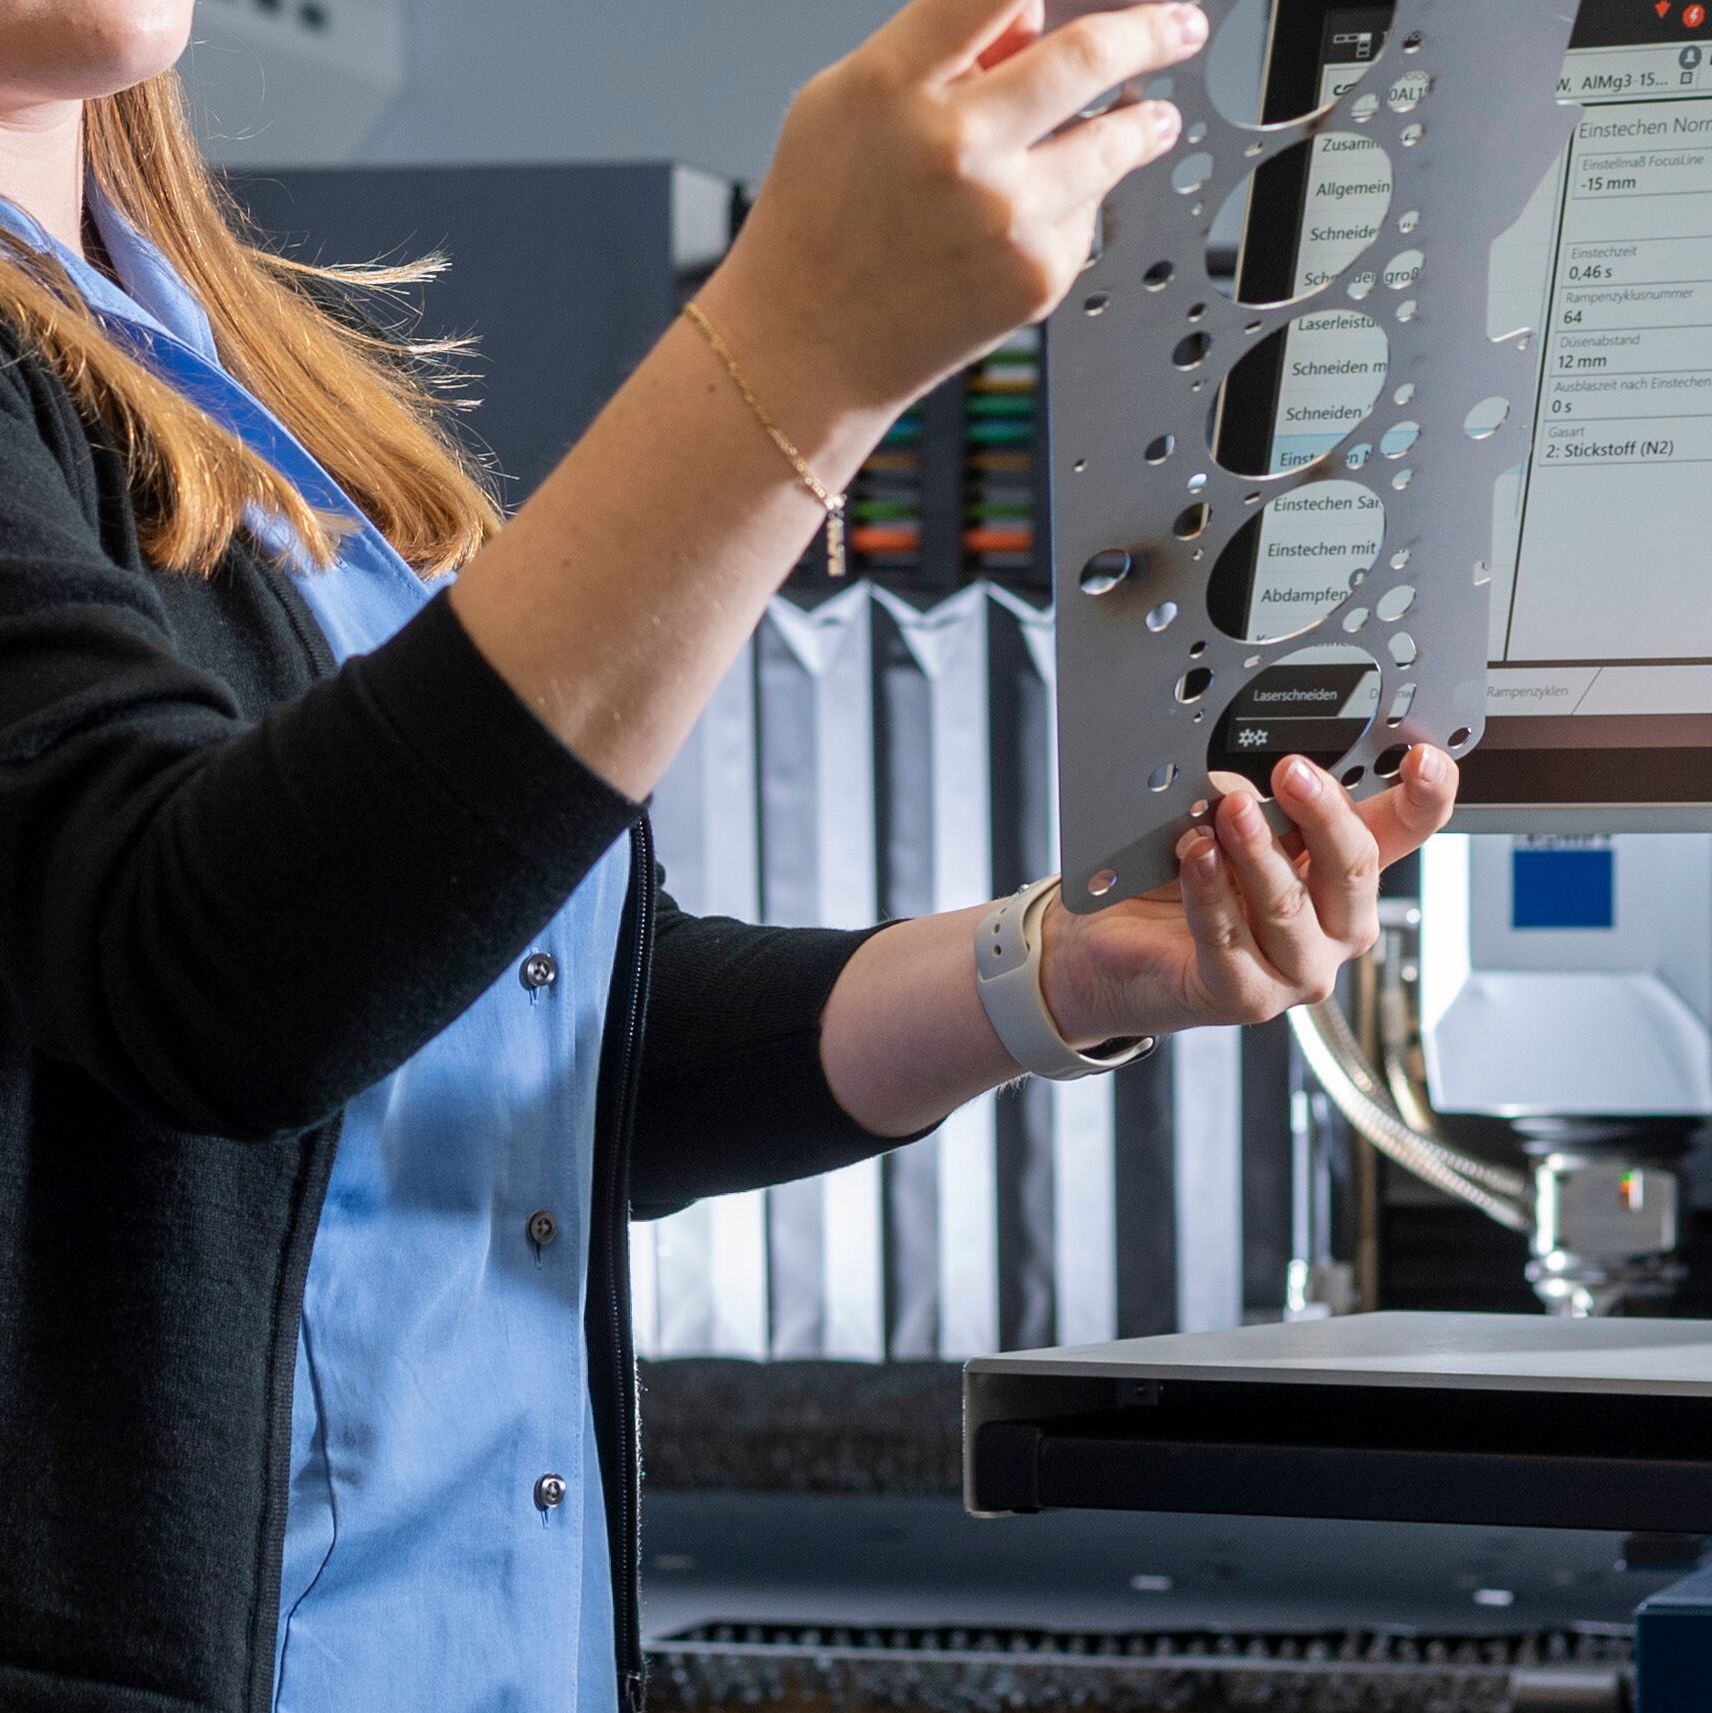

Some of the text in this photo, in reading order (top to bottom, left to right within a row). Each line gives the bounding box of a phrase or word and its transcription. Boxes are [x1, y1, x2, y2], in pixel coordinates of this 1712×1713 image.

[1579, 119, 1668, 139] Einstechen
[1583, 153, 1704, 171] Einstellmaß FocusLine
[1580, 177, 1636, 192] -15 mm
[1310, 225, 1379, 241] Schneide
[1571, 246, 1637, 260] Einstechzeit
[1569, 265, 1612, 282] 0,46 s
[1565, 288, 1693, 306] Rampenzyklusnummer
[1563, 310, 1582, 324] 64
[1560, 334, 1640, 348] Düsenabstand
[1292, 361, 1368, 376] Schneiden
[1558, 355, 1607, 369] 12 mm
[1554, 375, 1712, 393] Ausblaszeit nach Einstechen
[1286, 406, 1362, 421] Schneiden
[1551, 399, 1572, 414] 0 s
[1549, 425, 1585, 439] Gasart
[1546, 439, 1674, 458] 2: Stickstoff (N2)
[1274, 496, 1352, 512] Einstechen
[1268, 541, 1376, 558] Einstechen mit
[1261, 588, 1348, 605] Abdampfen
[1253, 689, 1337, 702] Laserschneiden
[1487, 685, 1569, 700] Rampenzyklen
